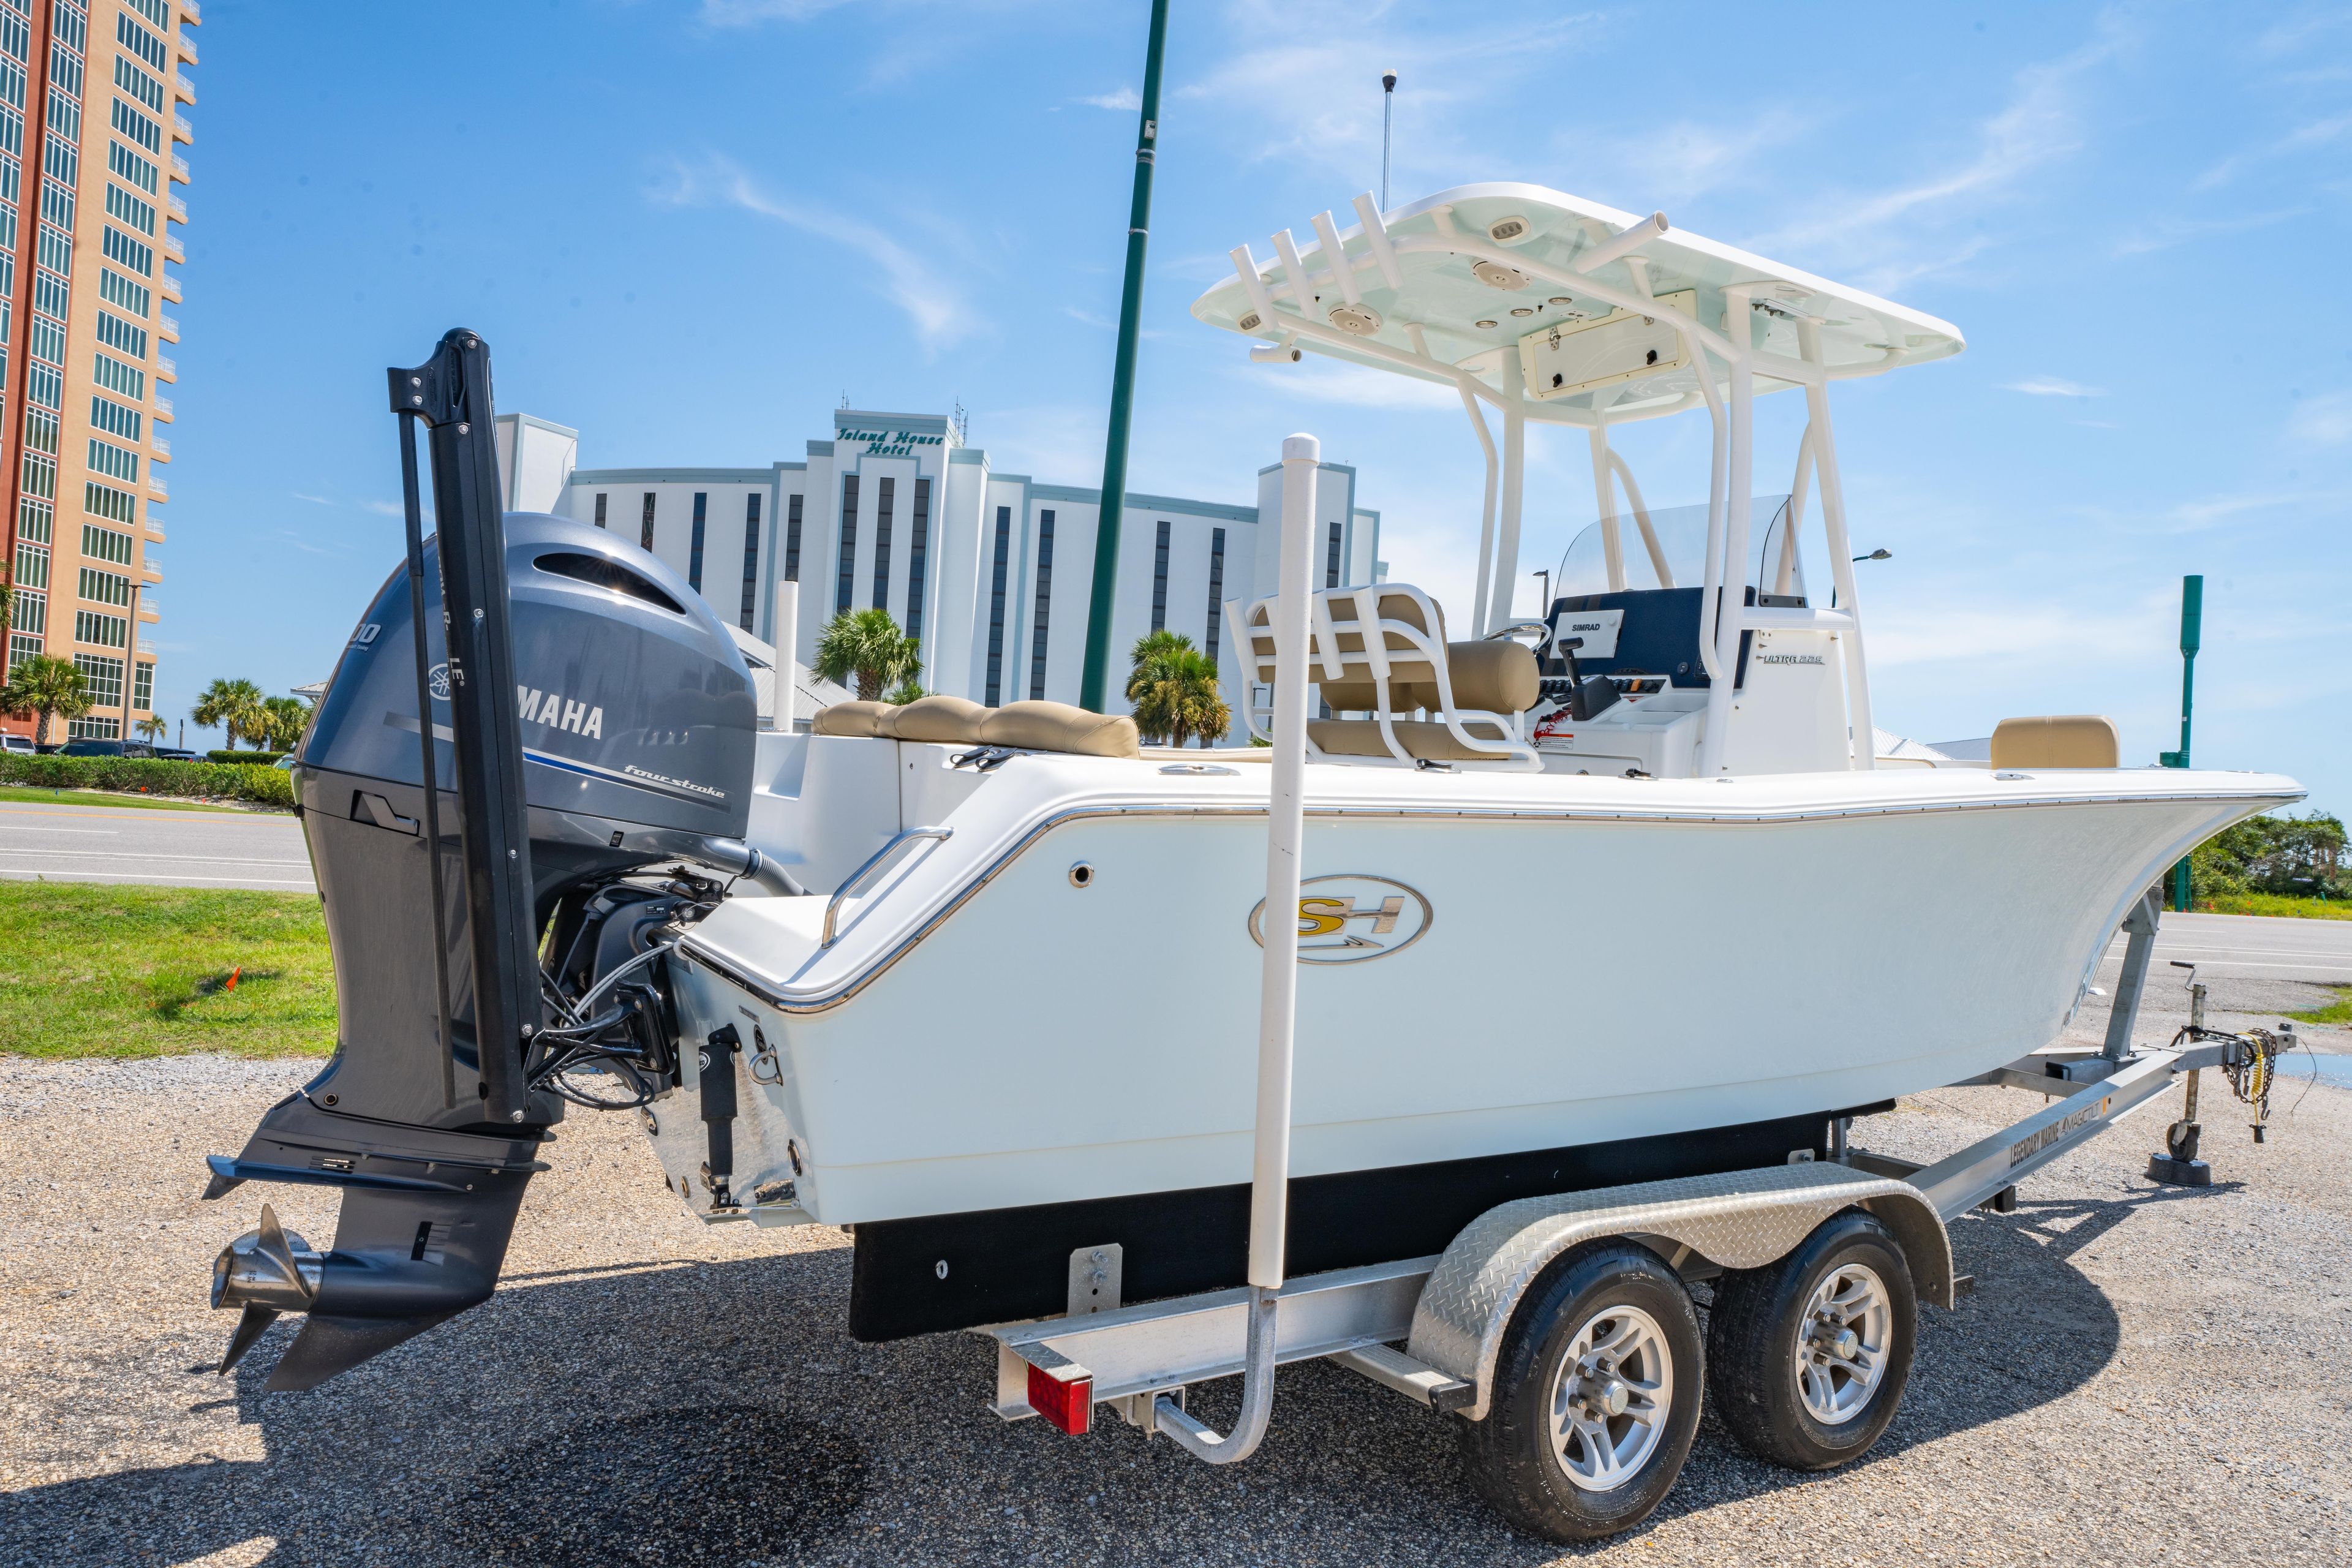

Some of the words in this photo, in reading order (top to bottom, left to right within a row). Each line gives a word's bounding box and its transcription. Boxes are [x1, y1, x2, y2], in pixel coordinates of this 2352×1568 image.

[837, 428, 889, 442] Island
[893, 431, 943, 445] House
[865, 442, 913, 456] Hotel
[349, 623, 381, 643] 00
[1764, 655, 1798, 665] ULTRA
[517, 685, 603, 740] MAHA
[2010, 1131, 2040, 1169] LEGENDARY
[2040, 1121, 2059, 1150] MARINE
